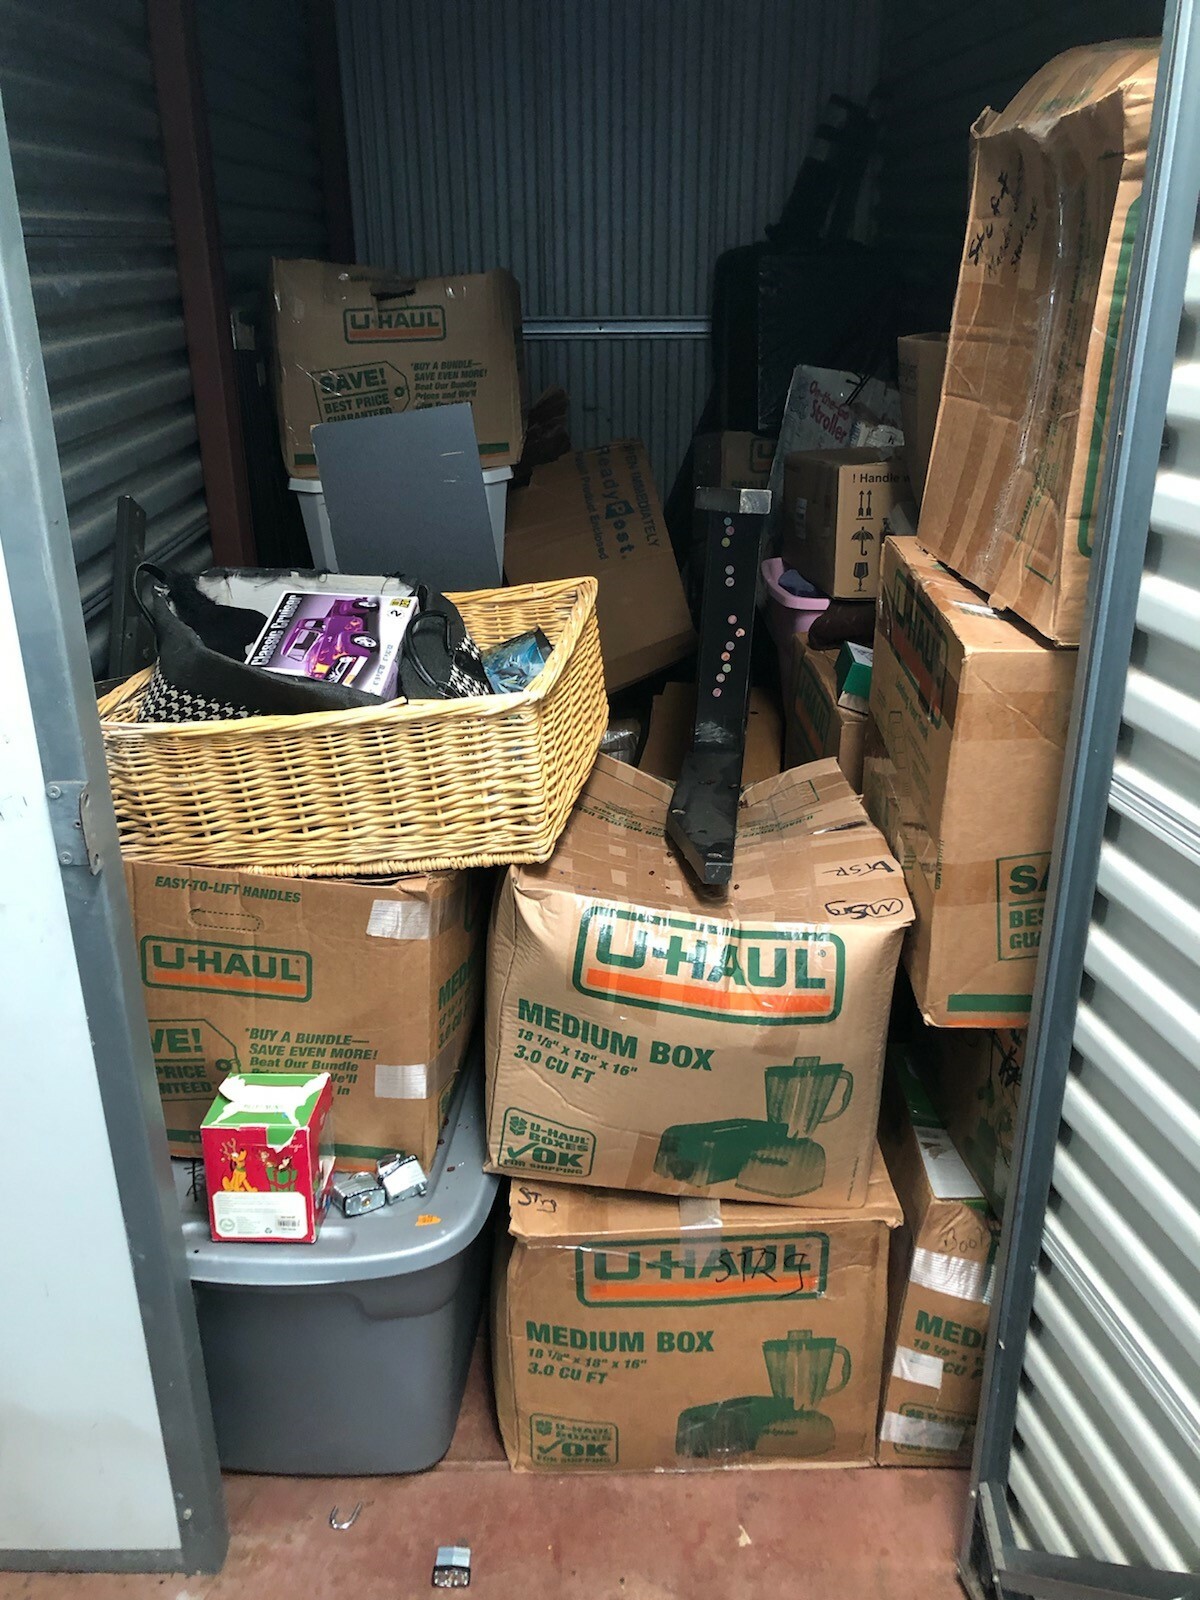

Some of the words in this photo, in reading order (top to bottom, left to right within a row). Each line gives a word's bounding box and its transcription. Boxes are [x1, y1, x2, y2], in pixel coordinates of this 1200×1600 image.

[319, 367, 387, 395] SAVE!
[414, 371, 435, 381] SAVE
[437, 370, 460, 380] EVEN
[461, 369, 488, 379] MORE!
[324, 399, 353, 414] BEST
[357, 393, 390, 409] PRICE
[810, 400, 848, 444] Stroller
[860, 473, 900, 483] Handle
[632, 472, 660, 546] IMMEDIATELY
[250, 629, 285, 666] Classic
[270, 594, 303, 630] Cruiser
[154, 876, 240, 896] EASY-TO-LIFT
[243, 885, 302, 903] HANDLES
[1009, 908, 1044, 929] BE
[150, 1028, 203, 1053] VE!
[281, 1031, 291, 1043] A
[518, 998, 638, 1059] MEDIUM
[649, 1040, 715, 1071] BOX
[248, 1043, 286, 1057] SAVE
[289, 1045, 326, 1058] EVEN
[330, 1048, 379, 1061] MORE!
[517, 1028, 533, 1041] 18
[537, 1033, 559, 1049] 1/8"
[561, 1045, 570, 1056] x
[574, 1049, 597, 1064] 18"
[599, 1060, 608, 1070] x
[612, 1063, 638, 1076] 16"
[249, 1056, 281, 1068] Beat
[284, 1058, 308, 1070] Our
[311, 1060, 359, 1072] Bundle
[513, 1044, 542, 1064] 3.0
[545, 1056, 570, 1075] CU
[571, 1066, 595, 1083] FT
[159, 1081, 212, 1095] NTEED
[337, 1085, 351, 1095] in
[529, 1132, 589, 1152] BOXES
[530, 1122, 588, 1144] U-HAUL
[532, 1147, 584, 1168] OK
[525, 1320, 645, 1353] MEDIUM
[656, 1330, 715, 1353] BOX
[915, 1309, 987, 1349] MED
[528, 1348, 544, 1359] 18
[585, 1357, 608, 1368] 18"
[624, 1359, 648, 1369] 16"
[528, 1362, 555, 1377] 3.0
[558, 1366, 582, 1381] CU
[586, 1371, 609, 1385] FT
[562, 1443, 608, 1457] OK
